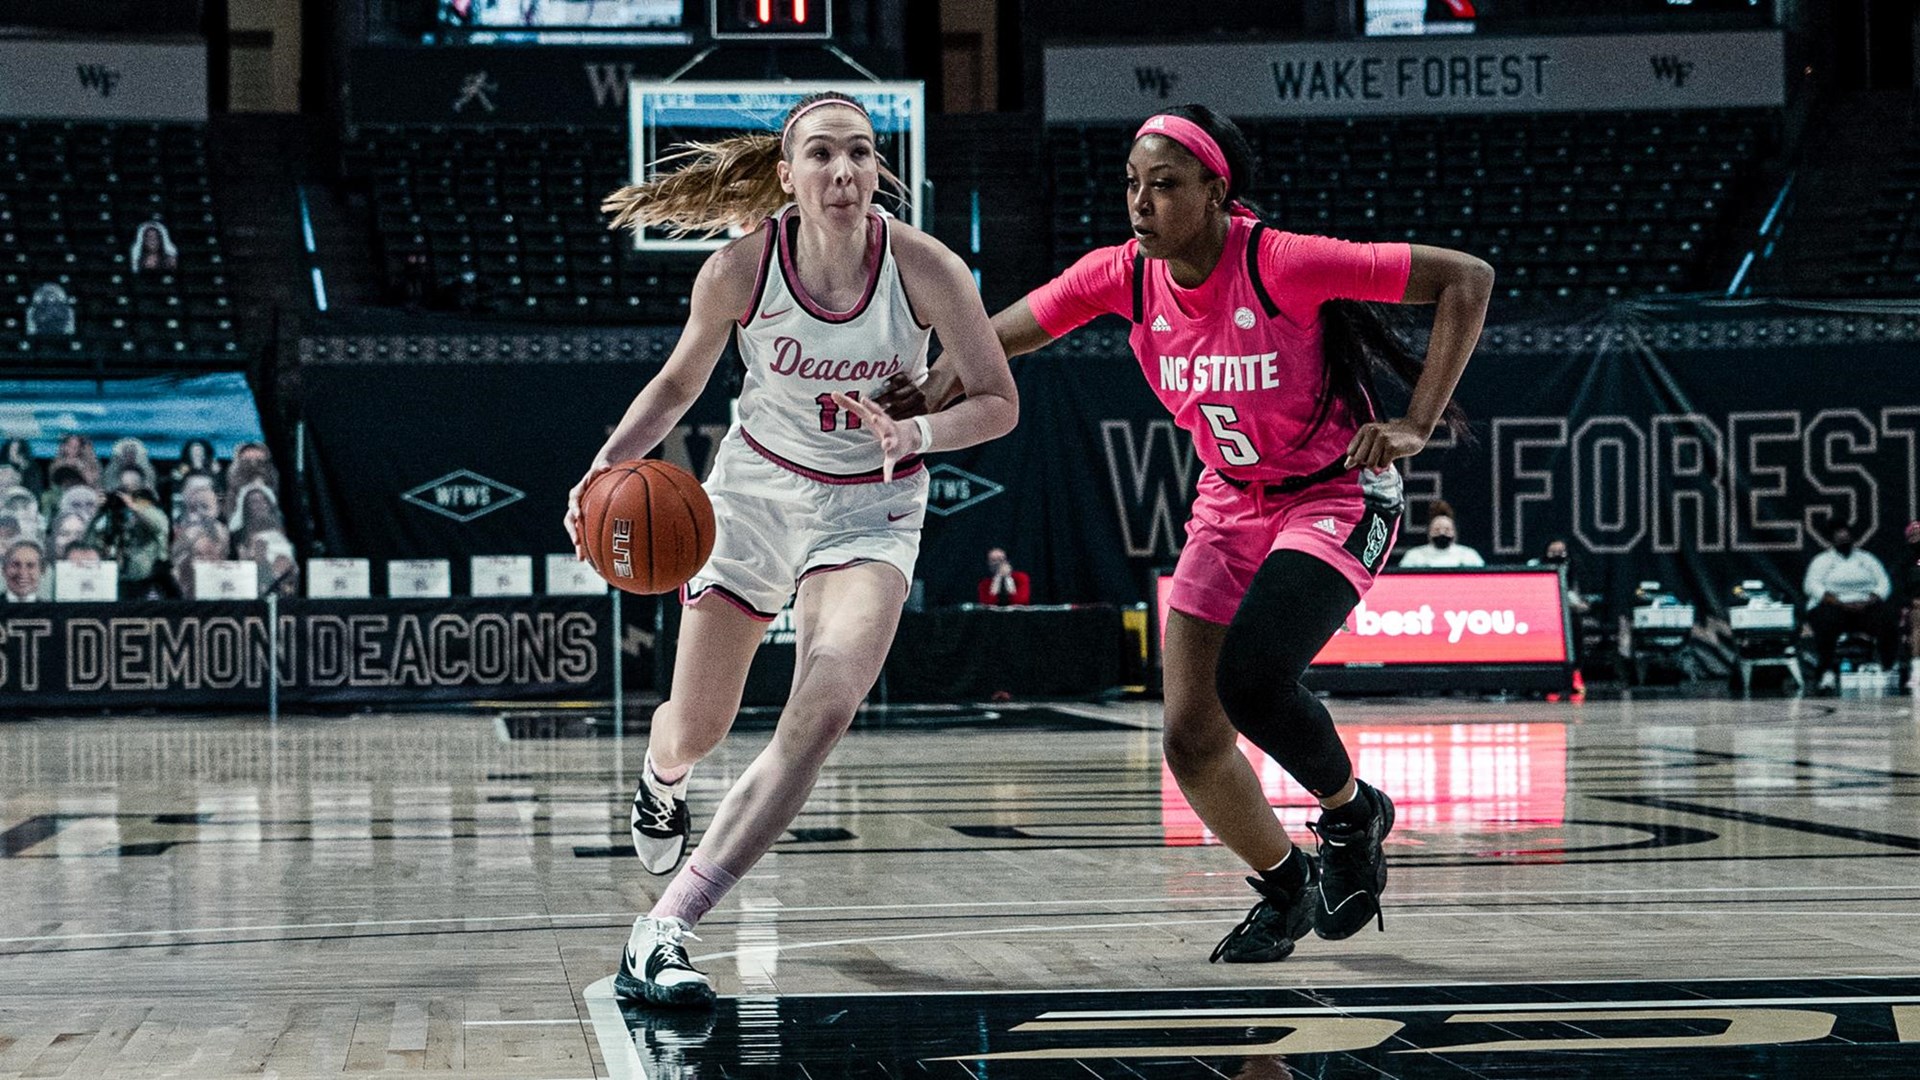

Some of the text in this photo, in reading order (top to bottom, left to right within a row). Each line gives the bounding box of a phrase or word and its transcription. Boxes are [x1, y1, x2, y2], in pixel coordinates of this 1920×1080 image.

[1272, 55, 1551, 100] WAKE FOREST
[769, 336, 903, 382] Deacons
[1159, 351, 1280, 392] NC STATE
[815, 391, 862, 432] 11
[1198, 403, 1262, 467] 5
[929, 479, 970, 500] FWS
[1101, 418, 1457, 557] WE
[1354, 599, 1529, 643] best you.
[0, 611, 598, 691] T DEMON DEACONS
